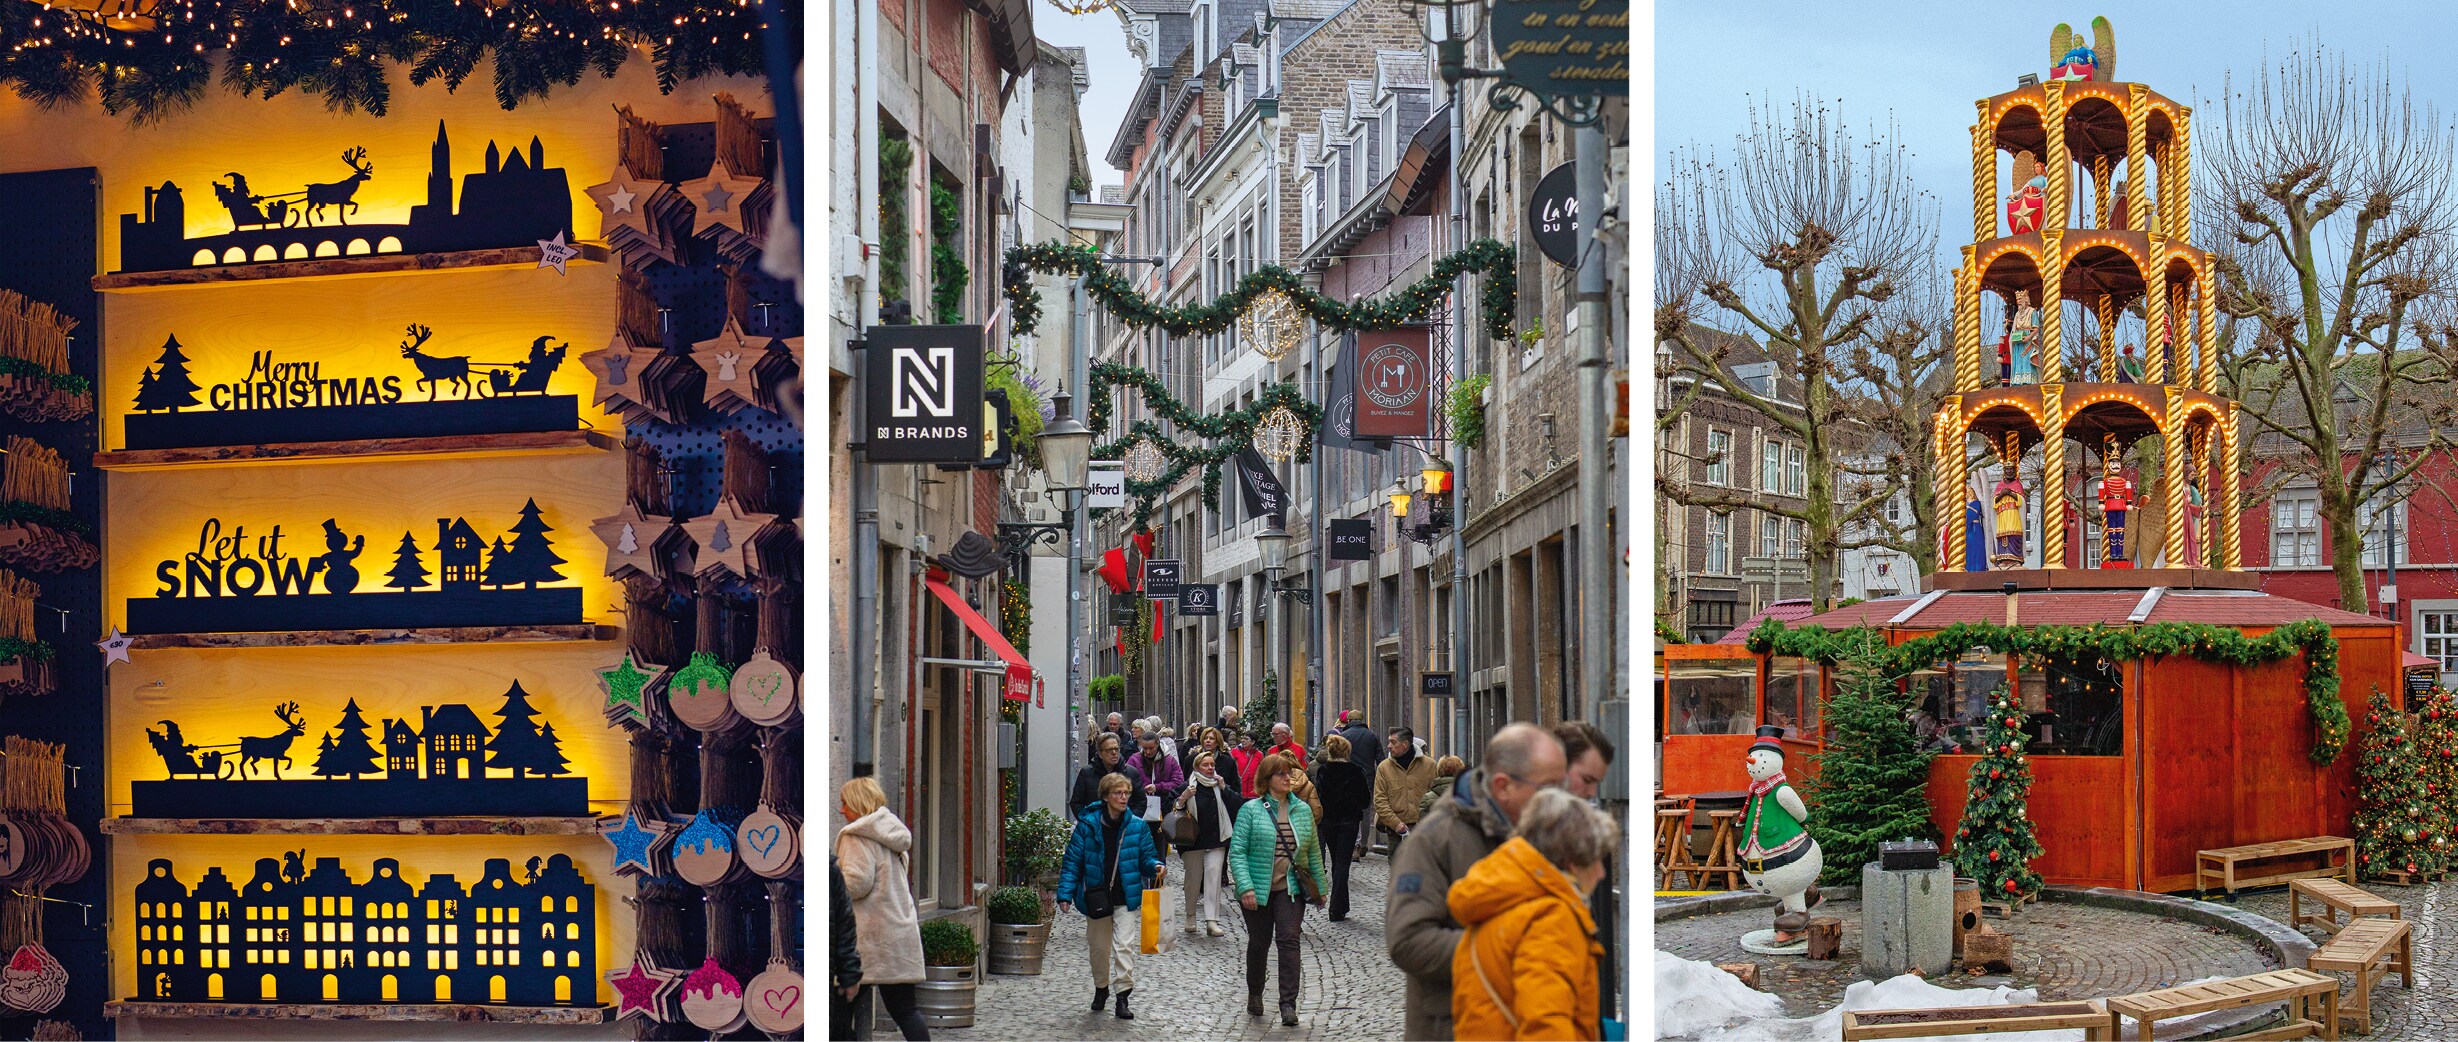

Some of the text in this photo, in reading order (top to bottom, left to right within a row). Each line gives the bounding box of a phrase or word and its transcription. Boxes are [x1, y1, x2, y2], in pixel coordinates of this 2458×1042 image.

[1543, 198, 1560, 222] La
[1543, 223, 1561, 232] DU
[546, 243, 567, 256] INCL.
[546, 254, 563, 265] LED
[1370, 347, 1391, 364] PETIT
[241, 349, 320, 394] Merry
[209, 374, 403, 412] CHRISTMAS
[1369, 388, 1416, 406] MORIAAN
[895, 426, 968, 439] BRANDS
[185, 517, 287, 569] Let it
[1336, 535, 1366, 544] BE ONE
[155, 556, 318, 600] SNOW
[1193, 592, 1203, 603] K
